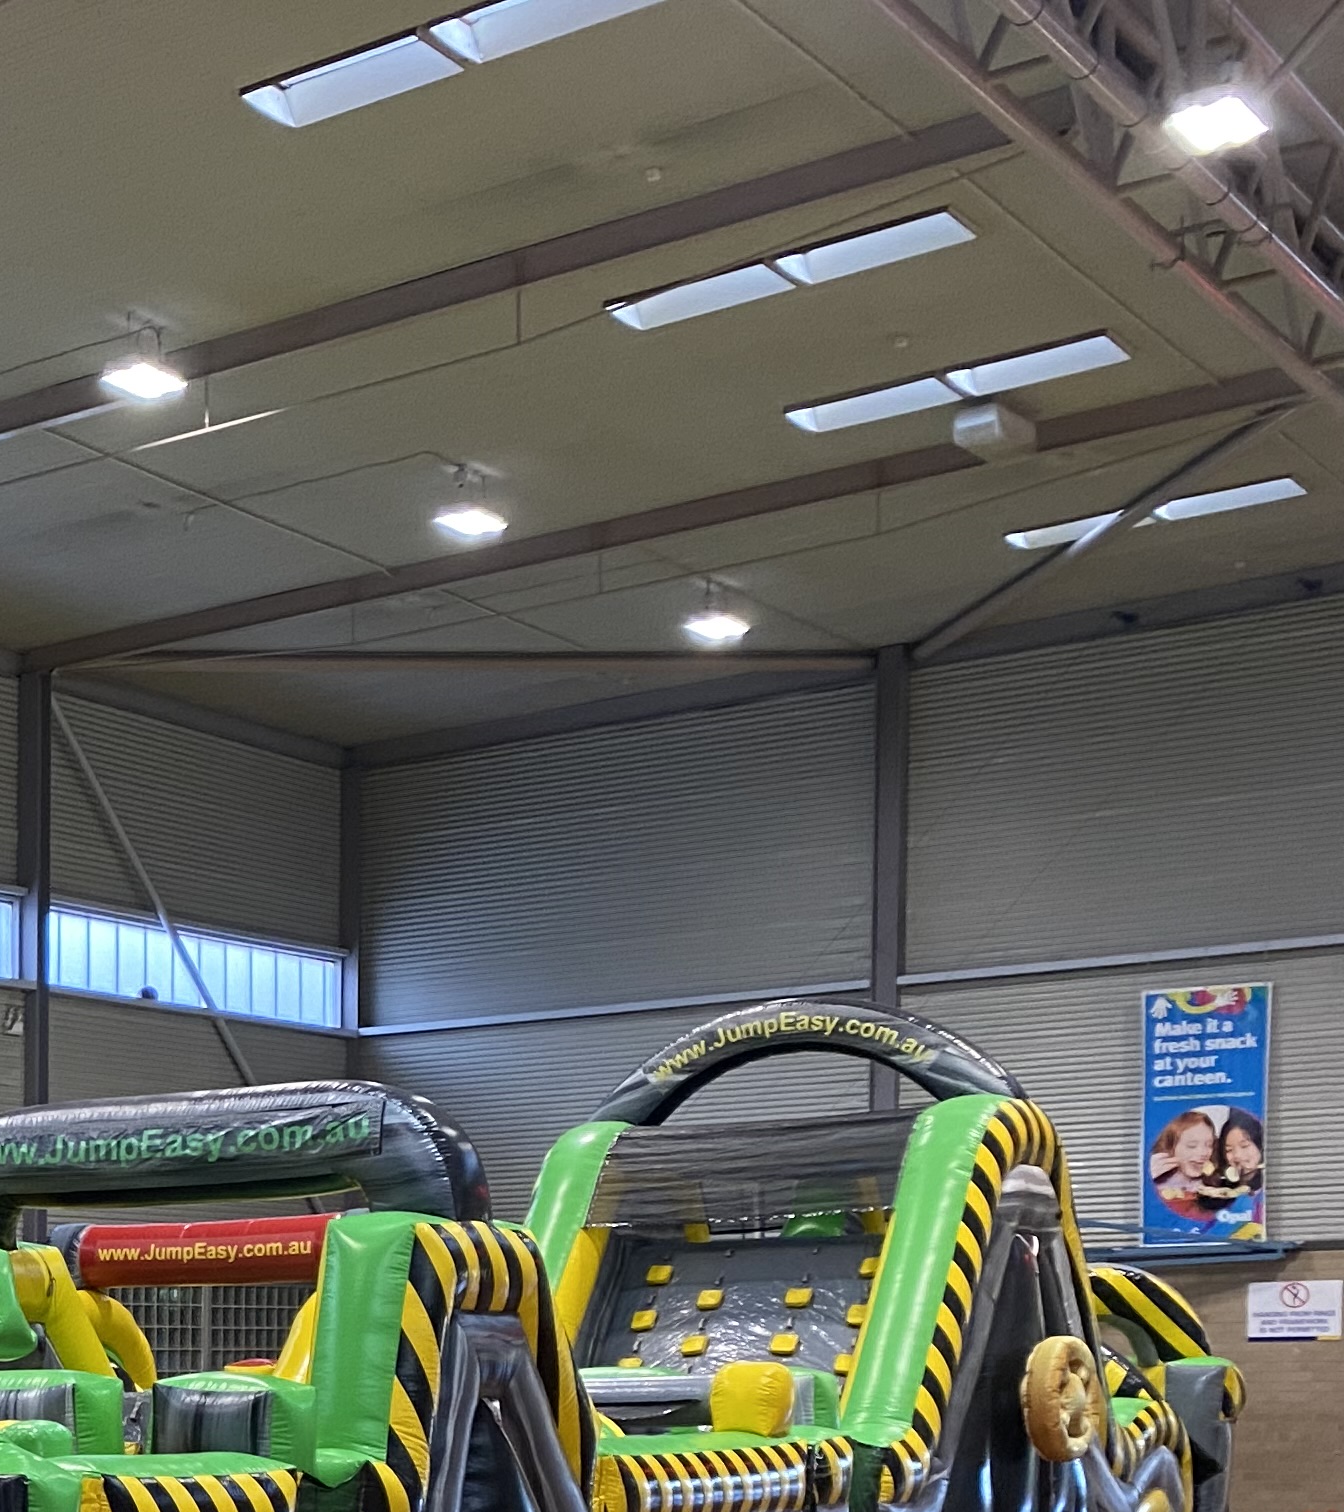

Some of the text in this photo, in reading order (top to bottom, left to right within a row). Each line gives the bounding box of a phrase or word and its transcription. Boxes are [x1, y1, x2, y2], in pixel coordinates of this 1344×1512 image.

[1155, 1018, 1233, 1037] Make it a
[654, 1011, 934, 1079] www.JumpEasy.com.au
[1154, 1033, 1257, 1054] fresh snack
[1154, 1055, 1218, 1073] at your
[1154, 1072, 1232, 1087] canteen.
[98, 1240, 312, 1263] www.JumpEasy.com.au
